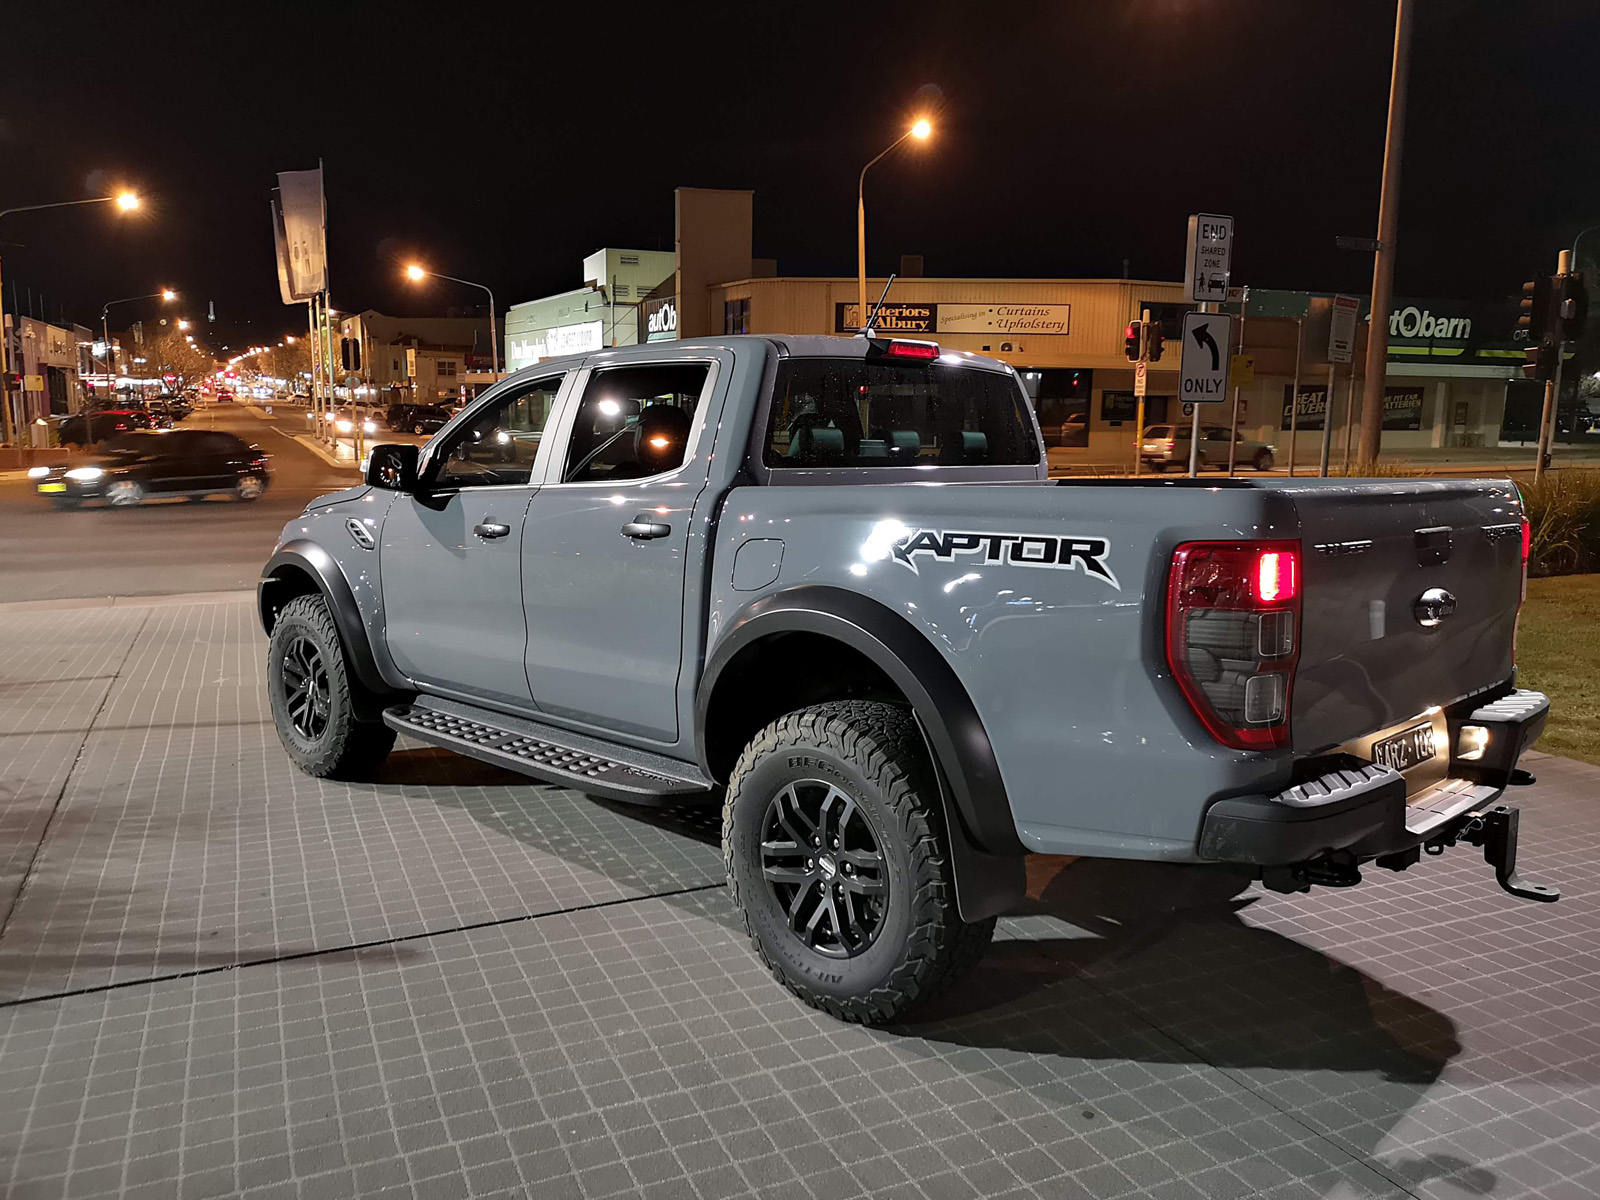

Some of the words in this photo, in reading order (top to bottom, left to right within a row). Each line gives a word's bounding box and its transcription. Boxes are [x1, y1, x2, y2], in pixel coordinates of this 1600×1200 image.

[1203, 224, 1226, 240] END
[1201, 246, 1226, 256] SHARED
[1204, 259, 1221, 268] ZONE
[940, 309, 978, 325] Specialising
[996, 306, 1051, 317] Curtains
[873, 316, 930, 332] Albury
[996, 318, 1065, 332] Upholstery
[1184, 378, 1223, 394] ONLY
